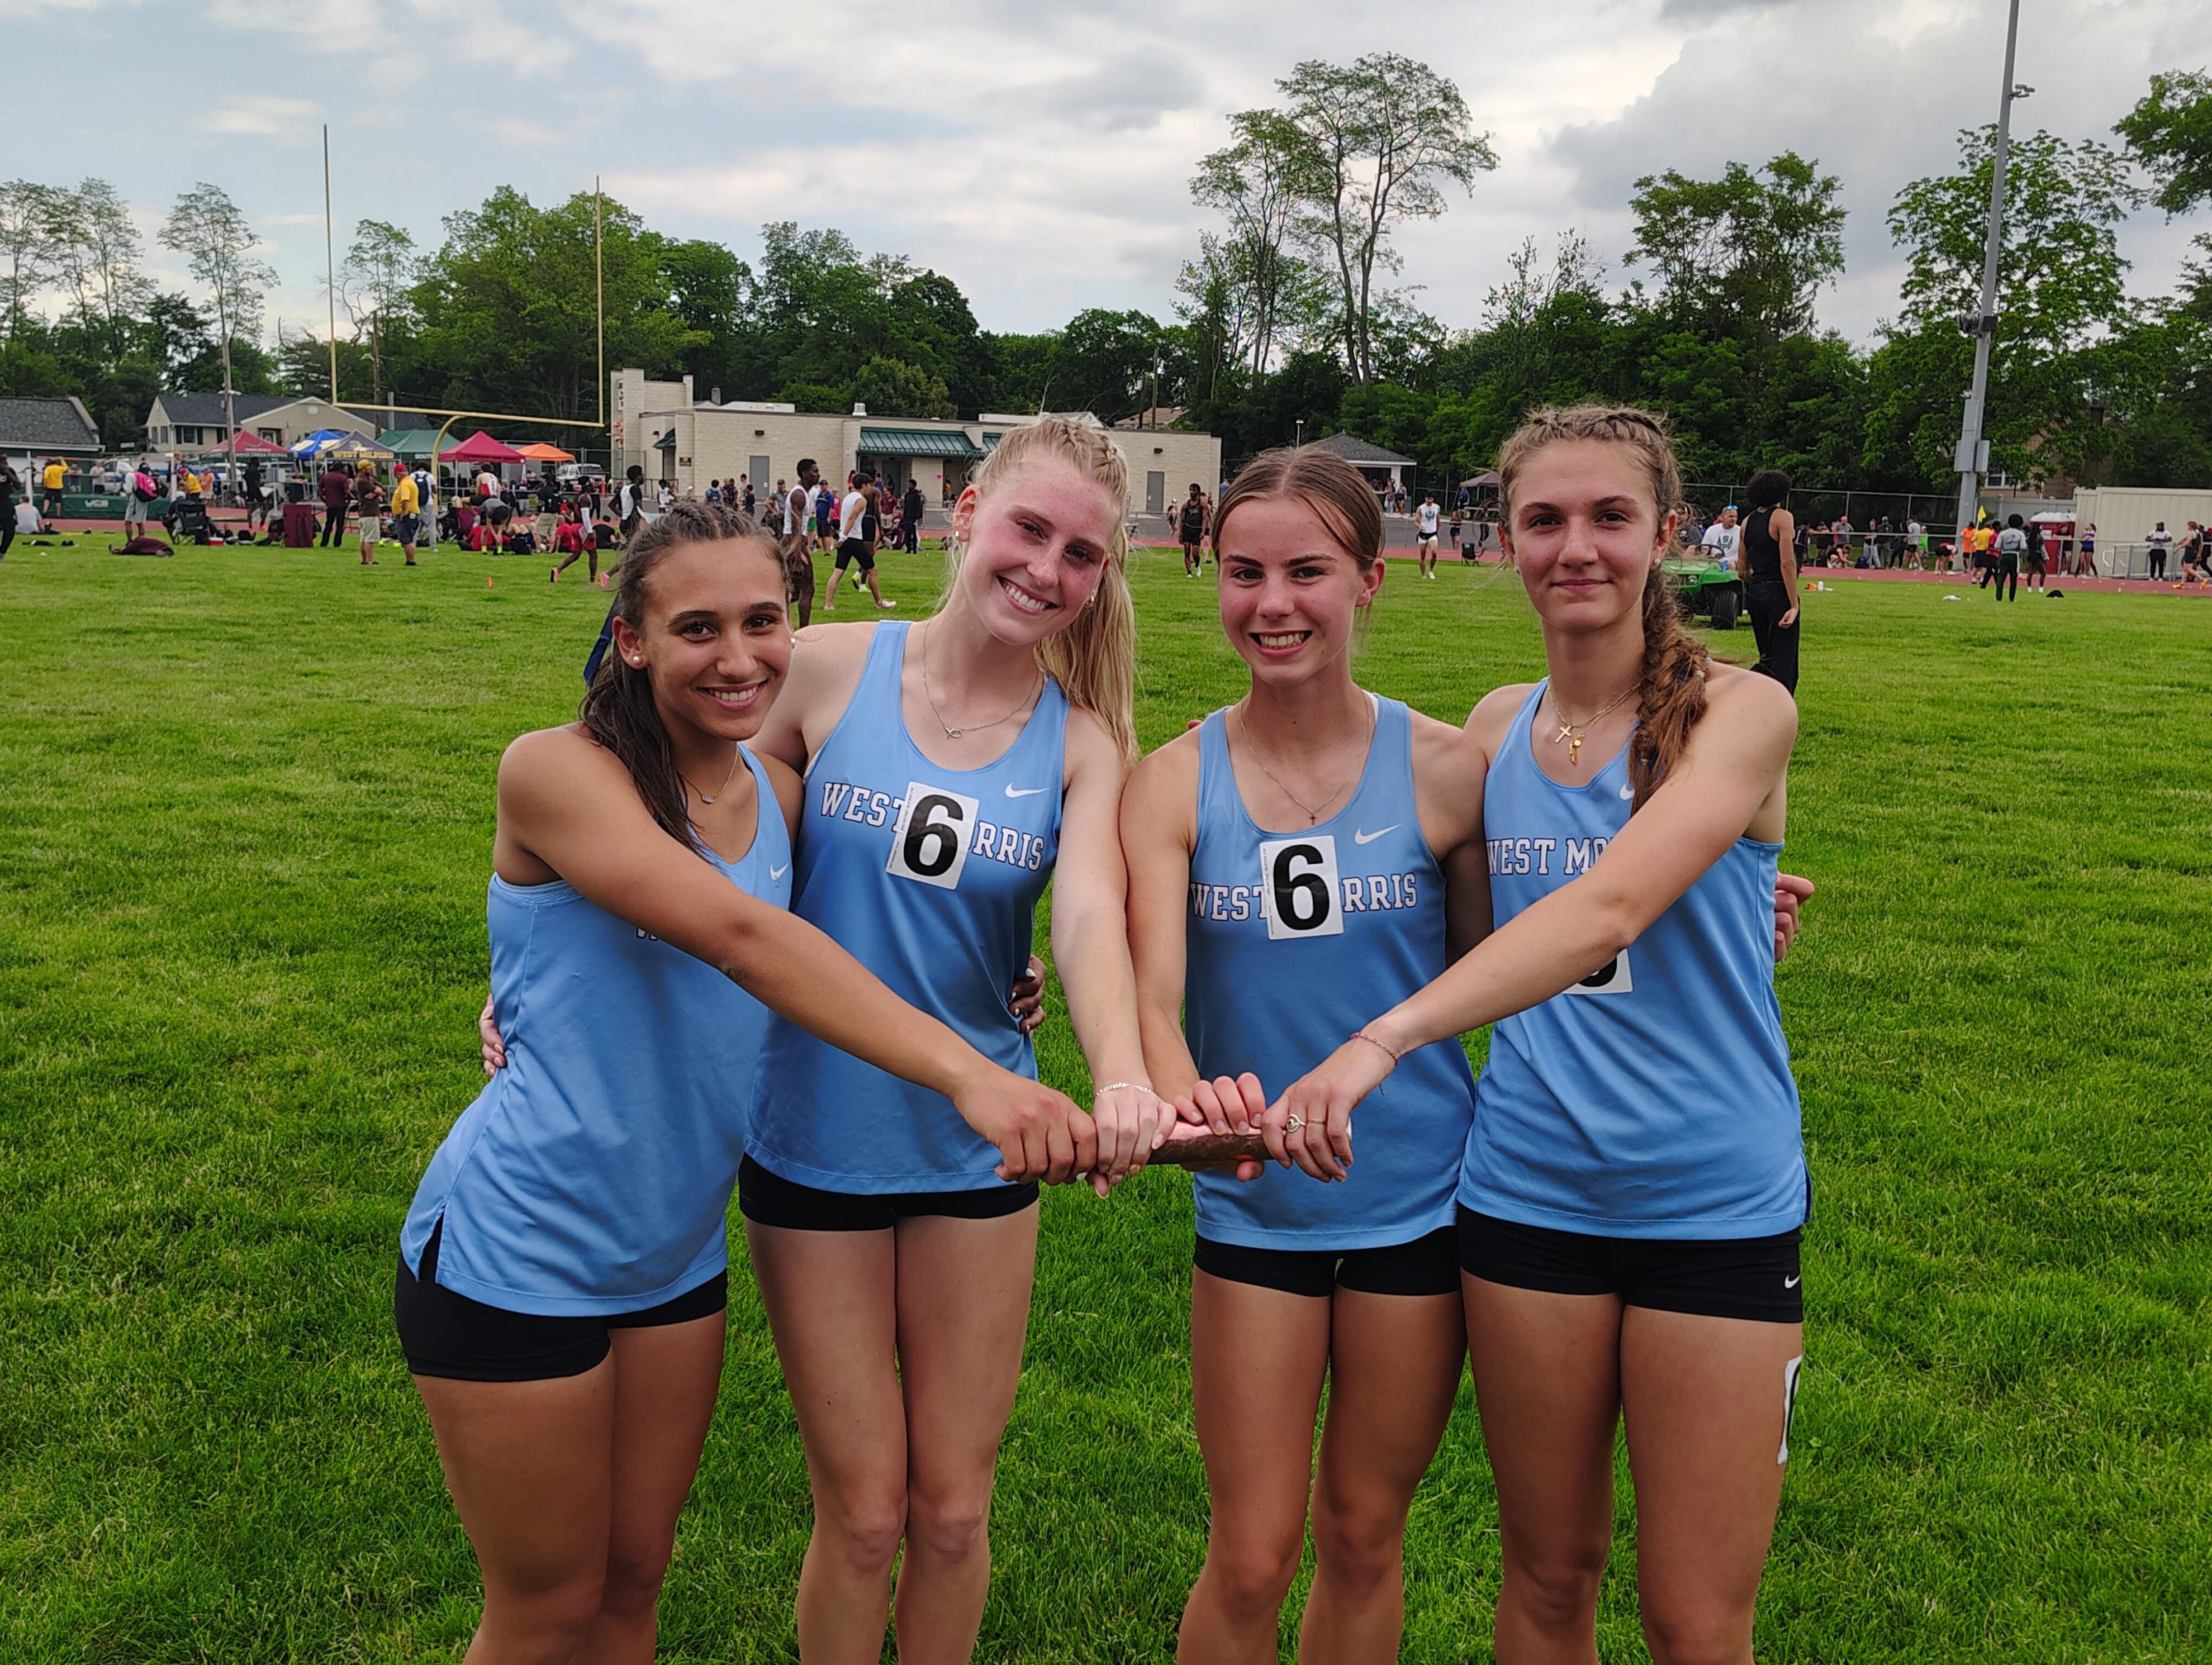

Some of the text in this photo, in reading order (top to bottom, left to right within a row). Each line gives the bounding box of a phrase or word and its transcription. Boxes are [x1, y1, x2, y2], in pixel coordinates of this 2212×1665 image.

[904, 794, 963, 876] 6
[968, 821, 1045, 872] RRIS
[1273, 844, 1330, 930] 6
[1342, 872, 1417, 913] RRIS
